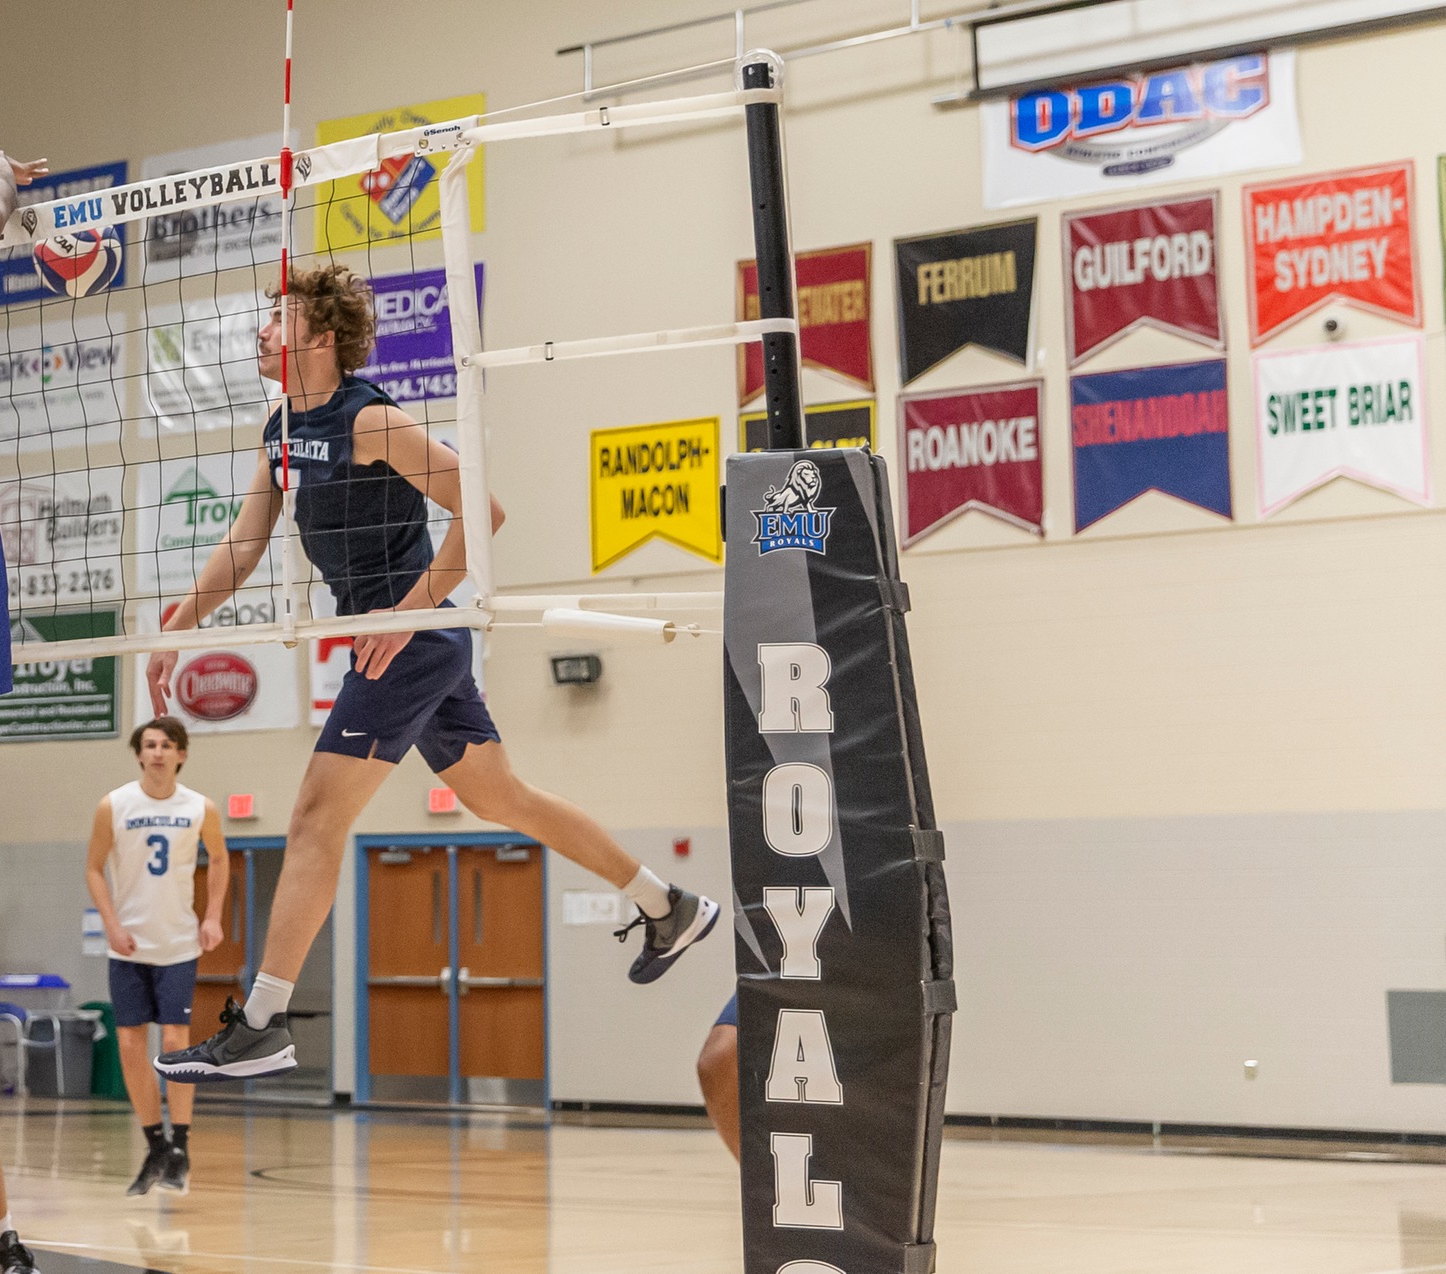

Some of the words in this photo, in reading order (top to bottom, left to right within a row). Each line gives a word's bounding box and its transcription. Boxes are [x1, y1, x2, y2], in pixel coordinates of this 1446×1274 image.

[1011, 53, 1270, 153] ODAC
[430, 125, 461, 136] Senoh
[54, 197, 103, 228] EMU
[111, 164, 277, 215] VOLLEYBALL
[1257, 186, 1404, 243] HAMPDEN-
[54, 235, 74, 254] CAA
[1074, 230, 1212, 292] GUILFORD
[1274, 237, 1390, 293] SYDNEY
[917, 250, 1018, 305] FERRUM
[367, 283, 448, 320] MEDICA
[64, 343, 120, 371] View
[1073, 389, 1228, 448] SHENANDOAH
[1267, 389, 1337, 437] SWEET
[1349, 381, 1413, 428] BRIAR
[600, 437, 710, 478] RANDOLPH-
[908, 415, 1037, 473] ROANOKE
[164, 489, 243, 525] Troy
[621, 483, 690, 520] MACON
[760, 513, 826, 539] EMU
[769, 537, 815, 547] ROYALS
[10, 568, 114, 597] 0-833-2276
[147, 834, 169, 876] 3
[757, 642, 846, 1274] ROYAL
